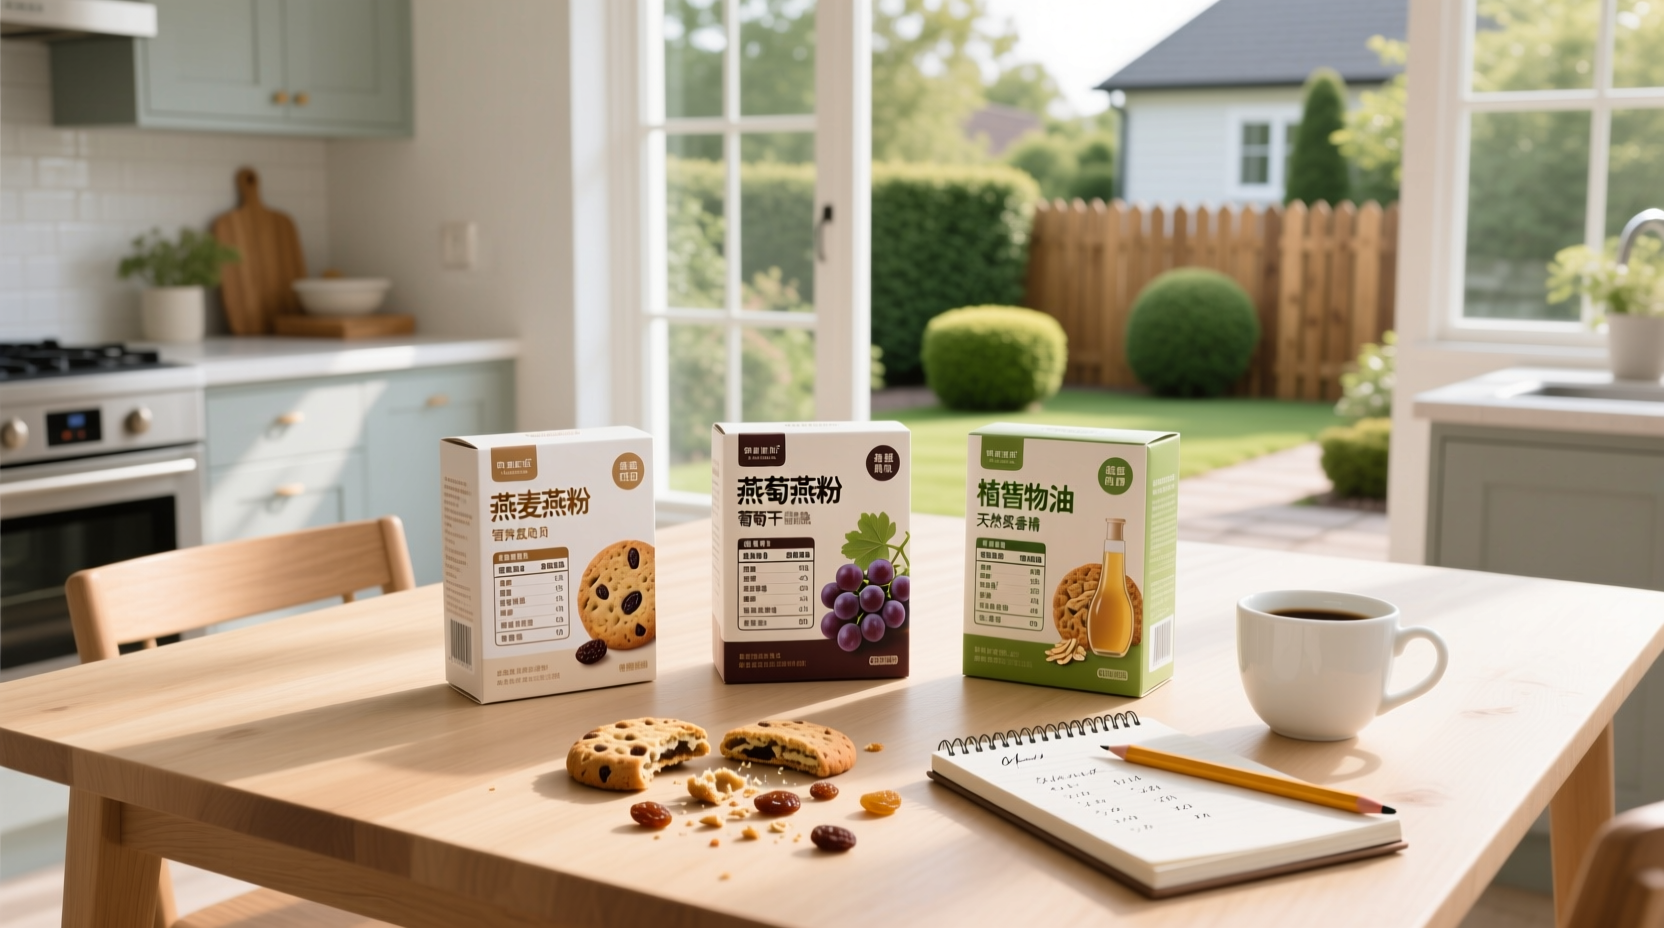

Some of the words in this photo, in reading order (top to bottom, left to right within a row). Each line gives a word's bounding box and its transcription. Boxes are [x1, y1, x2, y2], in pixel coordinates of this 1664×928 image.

[490, 487, 591, 522] 燕麦燕粉
[737, 475, 843, 505] 燕萄燕粉
